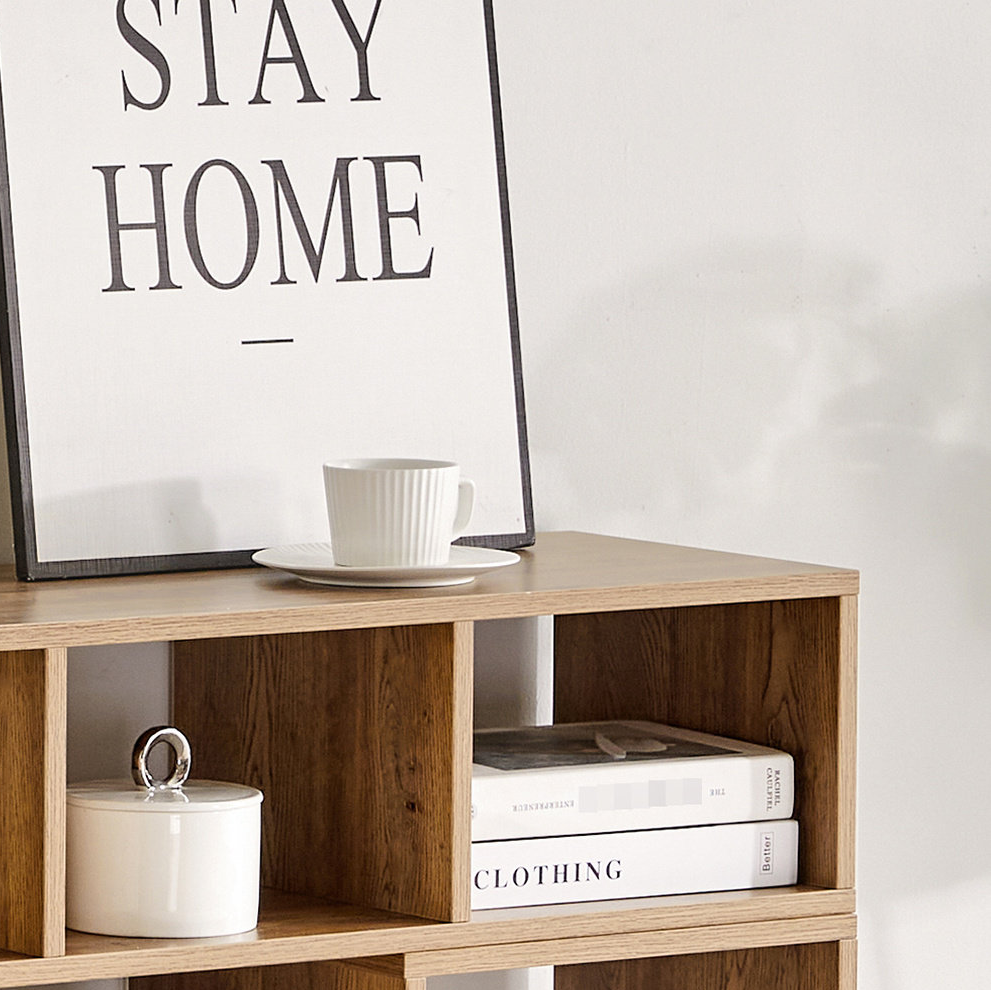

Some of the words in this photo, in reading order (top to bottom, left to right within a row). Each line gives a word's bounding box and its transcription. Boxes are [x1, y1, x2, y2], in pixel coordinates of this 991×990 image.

[116, 0, 382, 111] STAY
[92, 155, 434, 292] HOME
[474, 859, 623, 890] CLOTHING
